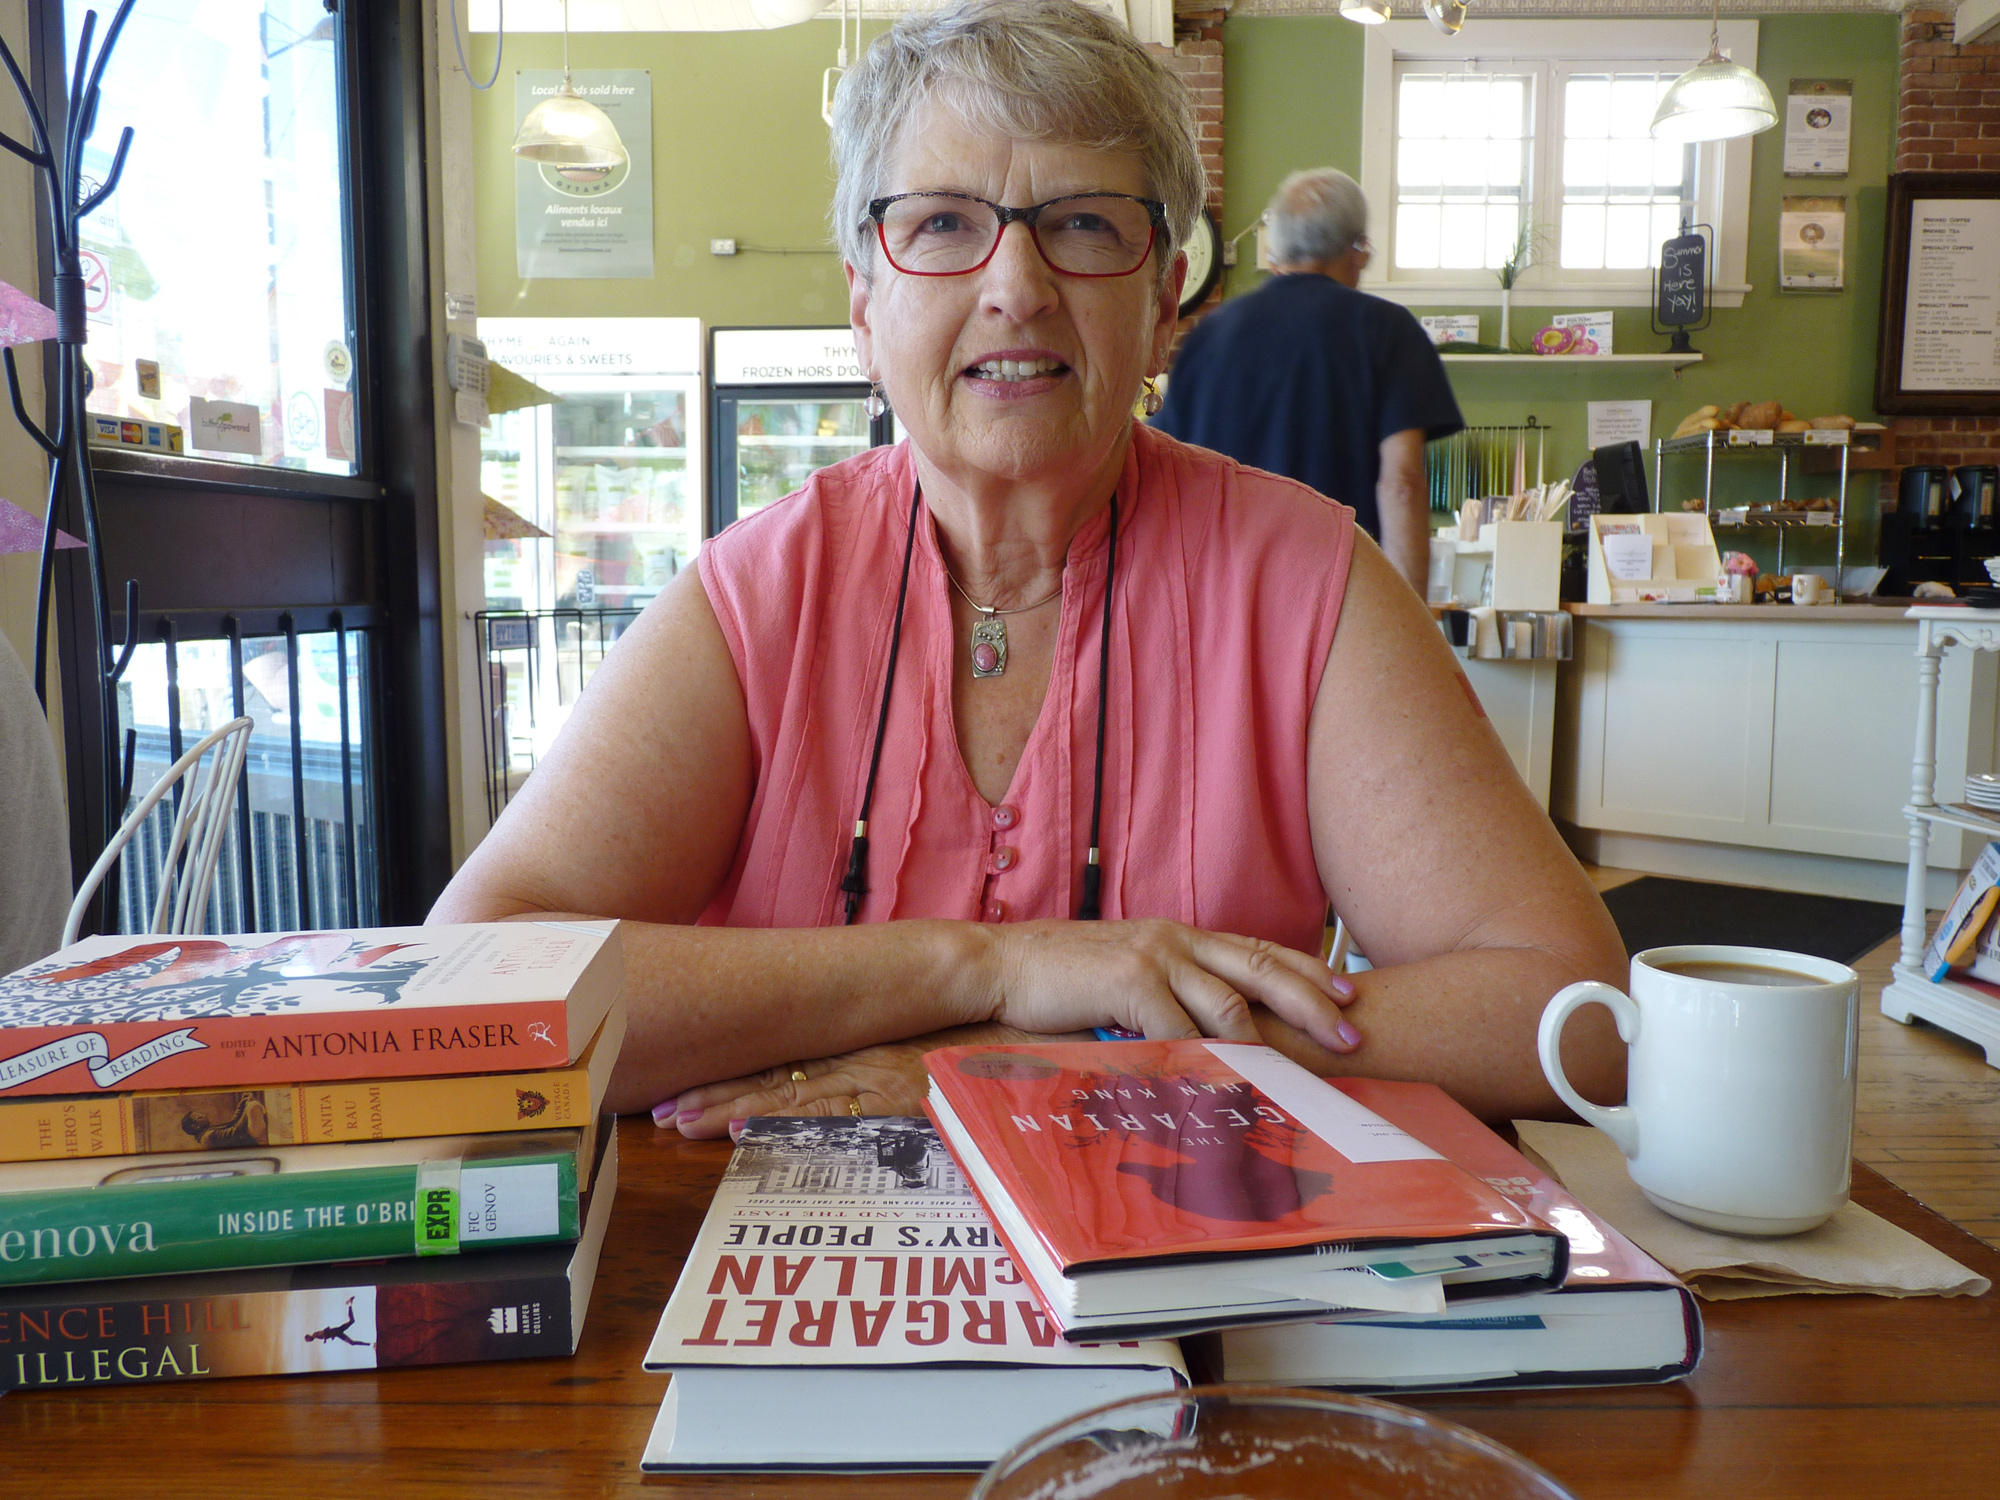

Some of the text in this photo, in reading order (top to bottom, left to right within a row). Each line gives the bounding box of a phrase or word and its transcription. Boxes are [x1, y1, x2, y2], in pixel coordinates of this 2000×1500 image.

[532, 85, 558, 95] Local
[590, 85, 610, 95] sold
[612, 85, 635, 95] here
[556, 181, 610, 193] OTTAWA
[545, 204, 624, 214] Aliments locaux
[560, 217, 608, 227] vendus ici
[548, 336, 590, 346] AGAIN
[491, 354, 632, 365] SAVOURIES & SWEETS
[742, 366, 793, 378] FROZEN
[798, 366, 833, 377] HORS
[100, 425, 116, 434] VISA
[527, 939, 576, 970] FRASER
[220, 1039, 256, 1059] EDITED BY
[261, 1023, 521, 1059] ANTONIA FRASER
[0, 1034, 186, 1081] LEASURE OF READING
[554, 1081, 562, 1121] VINTAGE
[564, 1082, 572, 1120] CANADA
[1072, 1083, 1243, 1100] HAN KANG
[319, 1094, 335, 1138] ANITA
[346, 1100, 358, 1130] RAU
[368, 1086, 384, 1140] BADAMI
[1010, 1106, 1287, 1132] GETARIAN
[38, 1118, 53, 1150] THE
[64, 1104, 80, 1158] HERO'S
[89, 1108, 104, 1153] WALK
[1181, 1137, 1224, 1146] THE
[218, 1200, 416, 1236] INSIDE THE O'BRI
[426, 1188, 452, 1242] EXPR
[468, 1211, 481, 1234] FIC
[485, 1182, 498, 1233] GENOV
[803, 1210, 848, 1218] THE
[0, 1220, 159, 1262] enova
[723, 1224, 997, 1248] RY'S PEOPLE
[706, 1255, 1024, 1296] cMILLAN
[0, 1299, 250, 1344] ENCE HILL
[522, 1304, 530, 1335] HARPER
[532, 1302, 542, 1335] COLLINS
[681, 1300, 1062, 1348] ARGARET
[16, 1343, 210, 1386] ILLEGAL
